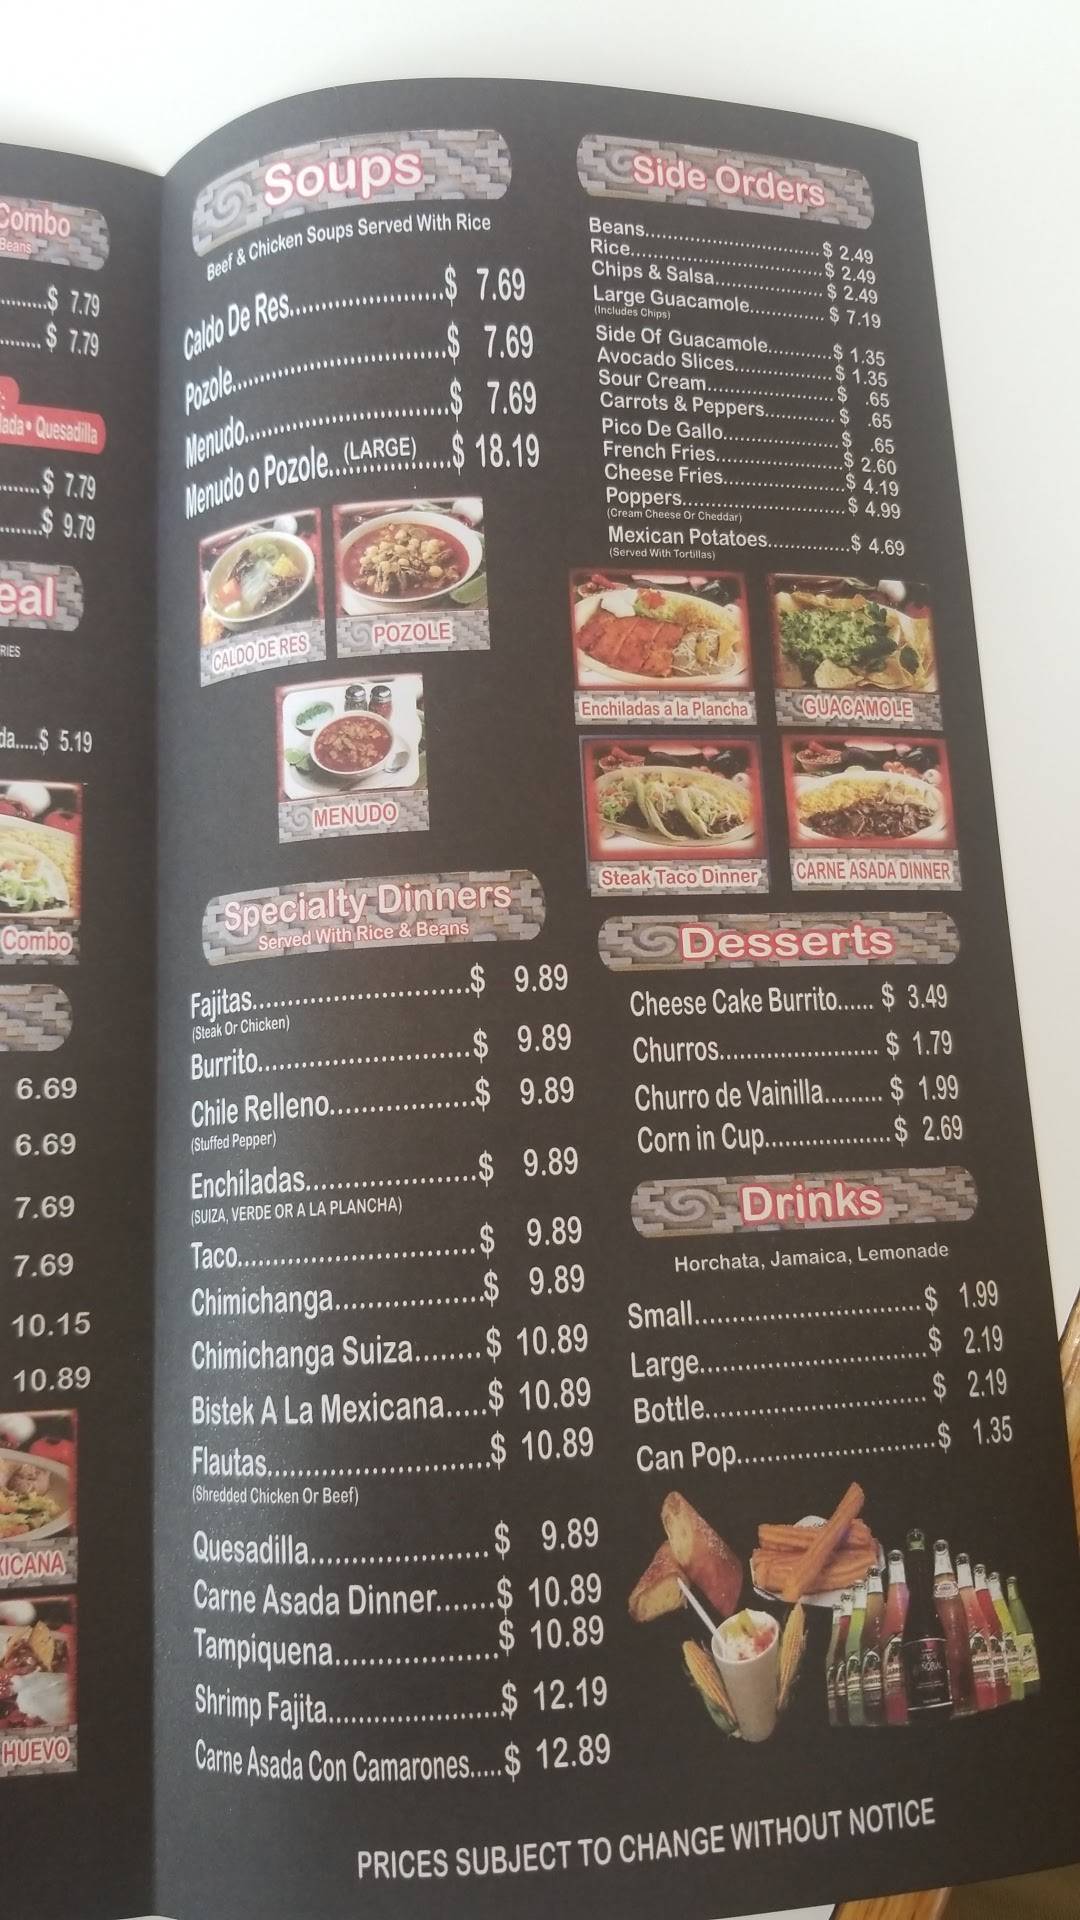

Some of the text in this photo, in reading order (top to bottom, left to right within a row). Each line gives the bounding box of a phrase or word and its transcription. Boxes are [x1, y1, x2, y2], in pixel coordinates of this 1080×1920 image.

[263, 153, 423, 207] Soups
[633, 155, 825, 205] Side Orders
[589, 217, 645, 237] Beans
[207, 213, 491, 281] Beef Chicken Soups Served With Rice
[591, 239, 630, 256] Rice
[592, 260, 878, 304] Chips Salsa 2.49
[593, 285, 881, 328] Large Guacamole 7.19
[184, 293, 290, 361] Caldo Res
[596, 325, 768, 353] Side Guacamole
[597, 347, 887, 387] Avocado Slices 1.35
[598, 369, 706, 391] Sour Cream
[186, 366, 233, 416] Pozole
[600, 392, 765, 419] Carrots Peppers
[36, 415, 97, 445] Quesadilla
[186, 417, 245, 469] Menudo
[602, 418, 724, 441] Pico Gallo
[603, 441, 715, 462] French Fries
[65, 473, 96, 500] 7.79
[186, 433, 540, 519] Menudo Pozole (LARGE) 18.19
[605, 464, 723, 485] Cheese Fries
[606, 487, 901, 519] Poppers 4.99
[647, 509, 681, 521] Cheese
[64, 514, 96, 541] 9.79
[608, 525, 767, 548] Mexican Potatoes
[649, 548, 670, 558] With
[374, 623, 451, 644] POZOLE
[212, 636, 308, 672] CALDO RES
[582, 701, 748, 717] Enchiladas Plancha
[803, 698, 913, 717] GUACAMOLE
[59, 730, 92, 753] 5.19
[314, 804, 397, 828] MENUDO
[601, 869, 758, 886] Steak Taco Dinner
[796, 861, 950, 880] CARNE ASADA DINNER
[224, 882, 511, 936] Specialty Dinners
[3, 930, 71, 954] Combo
[258, 922, 469, 951] Served With Rice Beans
[681, 925, 893, 958] Desserts
[191, 988, 252, 1023] Fajitas
[630, 984, 948, 1016] Cheese Cake Burrito 3.49
[192, 1016, 290, 1043] (Steak Chicken)
[633, 1031, 953, 1063] Churros 1.79
[191, 1048, 258, 1080] Burrito
[191, 1093, 329, 1128] Chile Relleno
[635, 1079, 823, 1111] Churro Vainilla
[15, 1132, 76, 1156] 6.69
[191, 1131, 277, 1154] (Stuffed Pepper)
[637, 1115, 963, 1154] Corn Cup 2.69
[191, 1167, 305, 1200] Enchiladas
[14, 1196, 75, 1219] 7.69
[191, 1196, 402, 1227] (SUIZA, VERDE PLANCHA)
[742, 1182, 883, 1222] Drinks
[13, 1253, 74, 1278] 7.69
[190, 1242, 238, 1269] Taco
[675, 1242, 949, 1272] Horchata, Jamaica, Lemonade
[191, 1264, 585, 1319] Chimichanga 9.89
[628, 1280, 998, 1329] Small 1.99
[12, 1312, 91, 1337] 10.15
[191, 1334, 413, 1374] Chimichanga Suiza
[631, 1351, 700, 1382] Large
[192, 1392, 444, 1425] Bistek Mexicana
[634, 1368, 1007, 1424] Bottle 2.19
[192, 1427, 594, 1477] Flautas 10.89
[637, 1415, 1012, 1472] Can Pop 1.35
[192, 1485, 359, 1506] (Shredded Chicken Beef)
[193, 1517, 599, 1565] Quesadilla 9.89
[194, 1573, 601, 1615] Carne Asada Dinner 10.89
[194, 1615, 604, 1671] Tampiquena 10.89
[195, 1676, 607, 1730] Shrimp Fajita 12.19
[3, 1739, 69, 1764] HUEVO
[195, 1734, 610, 1783] Carne Asada Con Camarones 12.89
[358, 1798, 936, 1879] PRICES SUBJECT TO CHANGE WITHOUT NOTICE
